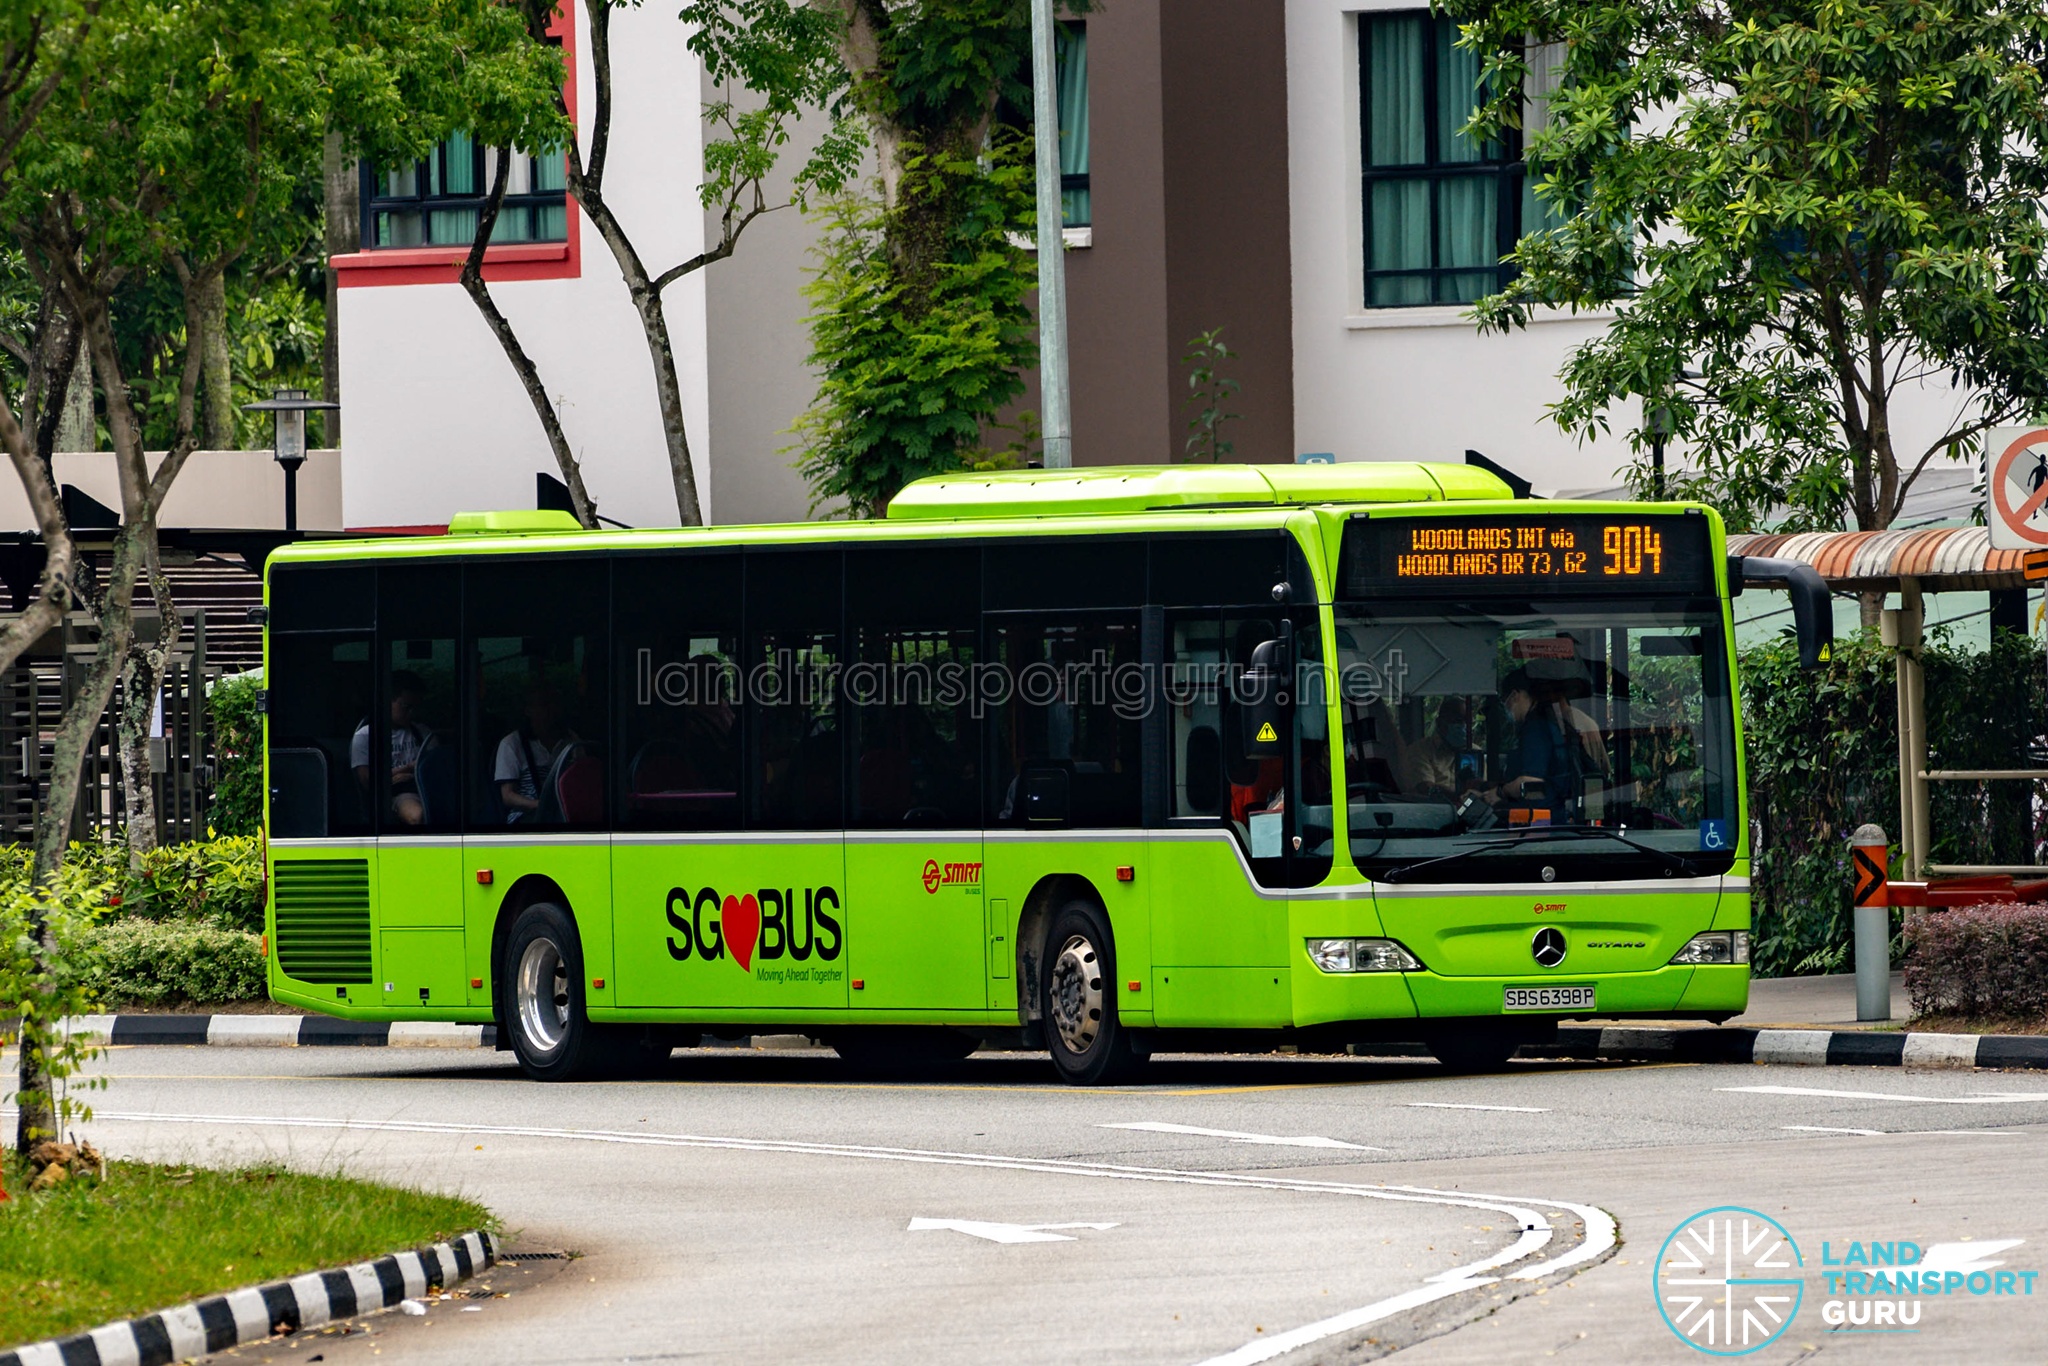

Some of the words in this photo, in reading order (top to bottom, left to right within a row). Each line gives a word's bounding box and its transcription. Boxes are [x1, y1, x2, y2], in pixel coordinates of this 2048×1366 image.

[1412, 528, 1512, 551] WOODLANDS
[1516, 527, 1546, 549] INT
[1550, 528, 1575, 549] via
[1603, 525, 1662, 575] 904
[1398, 553, 1498, 577] WOODLANDS
[1502, 553, 1524, 575] DR
[941, 862, 983, 883] SMRT
[1545, 904, 1567, 912] SMRT
[757, 885, 843, 962] BUS
[756, 968, 784, 985] Moving
[785, 967, 810, 981] Ahead
[811, 967, 843, 985] Together
[1506, 988, 1594, 1006] SBS6398P
